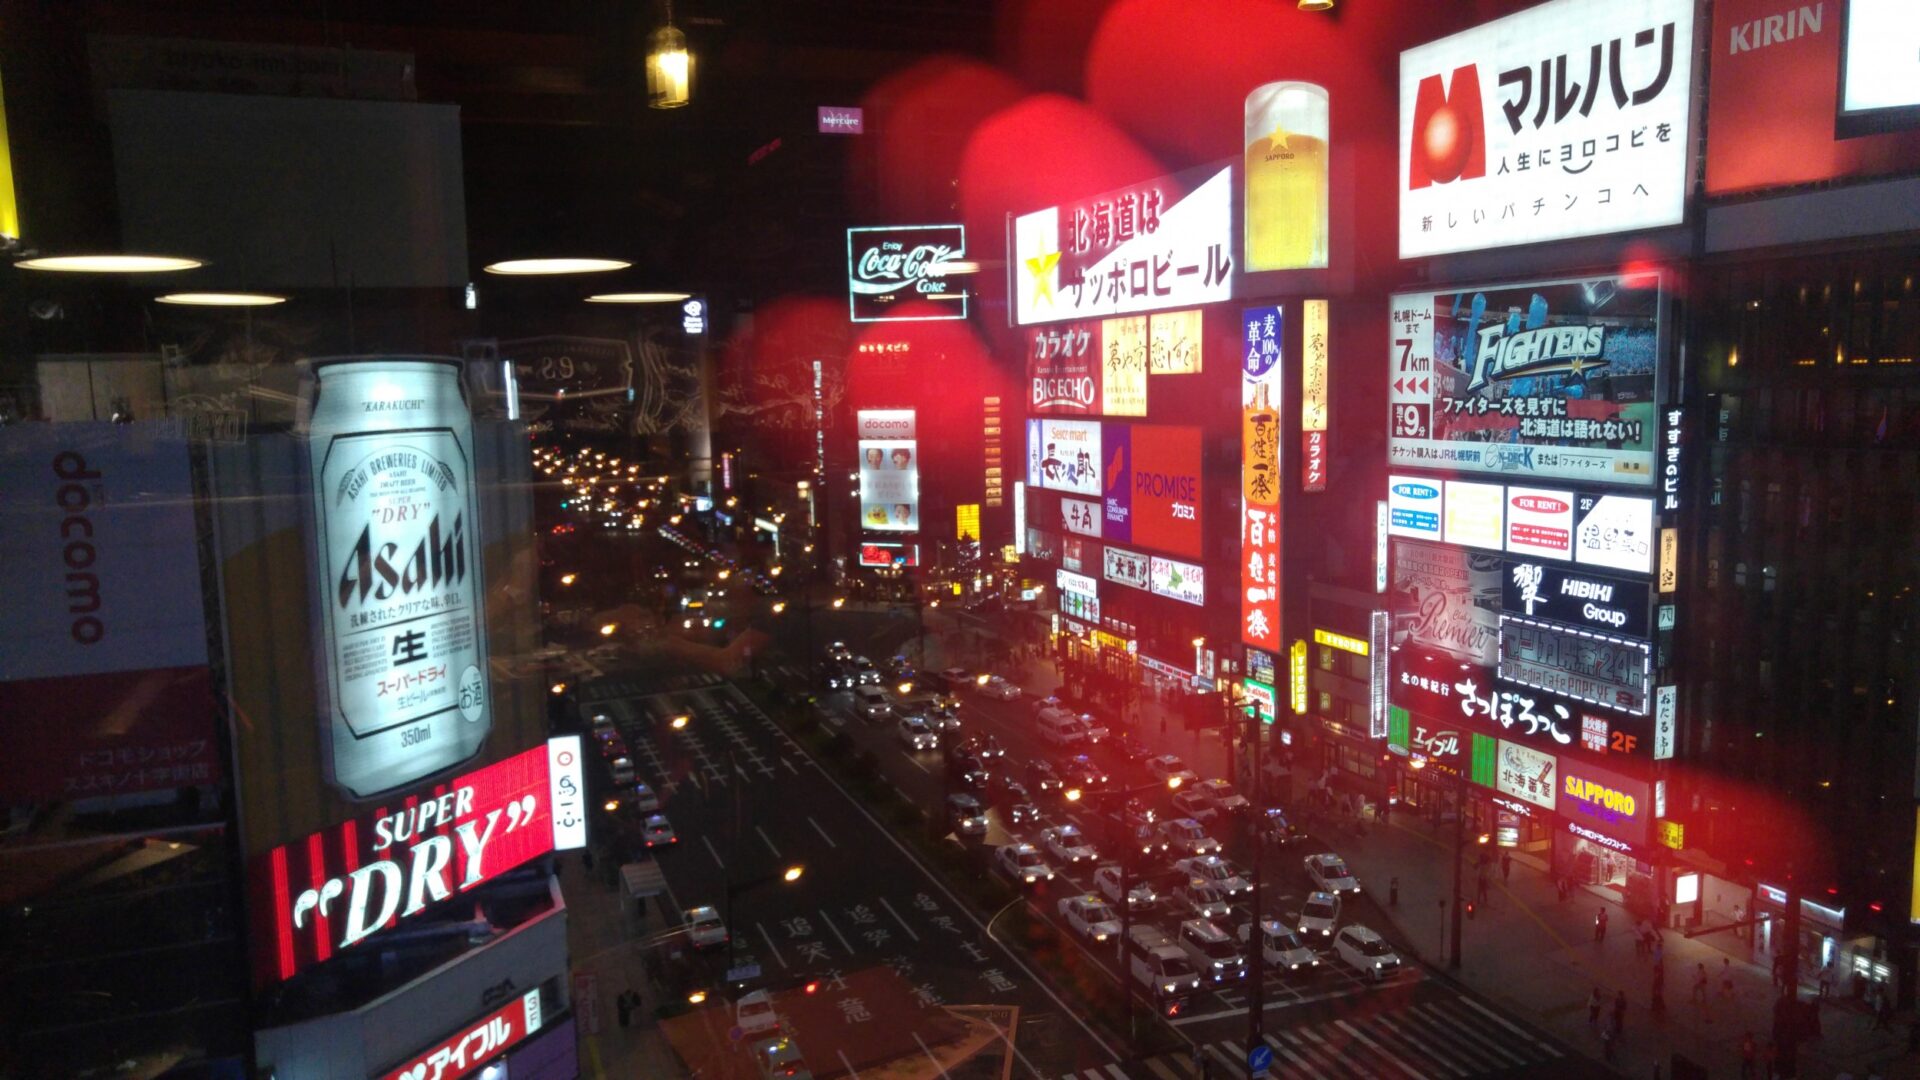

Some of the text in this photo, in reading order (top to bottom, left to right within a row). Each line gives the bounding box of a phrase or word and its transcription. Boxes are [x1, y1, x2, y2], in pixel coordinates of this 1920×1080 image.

[1729, 2, 1823, 55] KIRIN
[1499, 22, 1675, 135] マルハン
[822, 115, 859, 127] Mercure
[1264, 152, 1295, 162] SAPPORO
[1497, 122, 1672, 175] 人生にヨロコビを
[1068, 189, 1163, 254] 北海道は
[1421, 183, 1649, 233] 新しいパチンコへ
[916, 279, 946, 293] Coke
[1070, 243, 1232, 308] サッポロビール
[1394, 309, 1432, 323] 札幌ドーム
[1405, 323, 1420, 333] まで
[1035, 329, 1091, 359] カラオケ
[1247, 321, 1261, 373] 革命
[1395, 338, 1430, 372] 7km
[1466, 324, 1605, 393] FIGHTERS
[1033, 377, 1056, 404] BIG
[1057, 376, 1095, 405] ECHO
[1442, 397, 1566, 416] ファイターズを見ずに
[864, 417, 909, 430] docomo
[1308, 432, 1321, 483] カラオケ
[1537, 455, 1558, 466] または
[1664, 409, 1682, 510] すすきのビル
[347, 452, 448, 502] ASAHI BREWERIES LIMITED
[1136, 472, 1196, 502] PROMISE
[1070, 504, 1093, 530] 牛角
[1171, 502, 1196, 520] プロミス
[1519, 498, 1534, 508] FOR
[1580, 499, 1593, 510] 2F
[52, 450, 104, 646] docomo
[338, 510, 466, 609] Asahi
[1560, 579, 1613, 602] HIBIKI
[1409, 591, 1489, 650] Premier
[1583, 603, 1626, 627] Group
[391, 630, 428, 667] 生
[377, 664, 447, 697] スーパードライ
[1400, 671, 1450, 697] 北の味紀行
[1455, 678, 1571, 744] さっぽろっこ
[401, 724, 432, 747] 350ml
[1412, 726, 1459, 754] エイブル
[1612, 731, 1638, 752] 2F
[1564, 775, 1635, 816] SAPPORO
[372, 785, 474, 851] SUPER
[424, 1016, 511, 1080] アイフル
